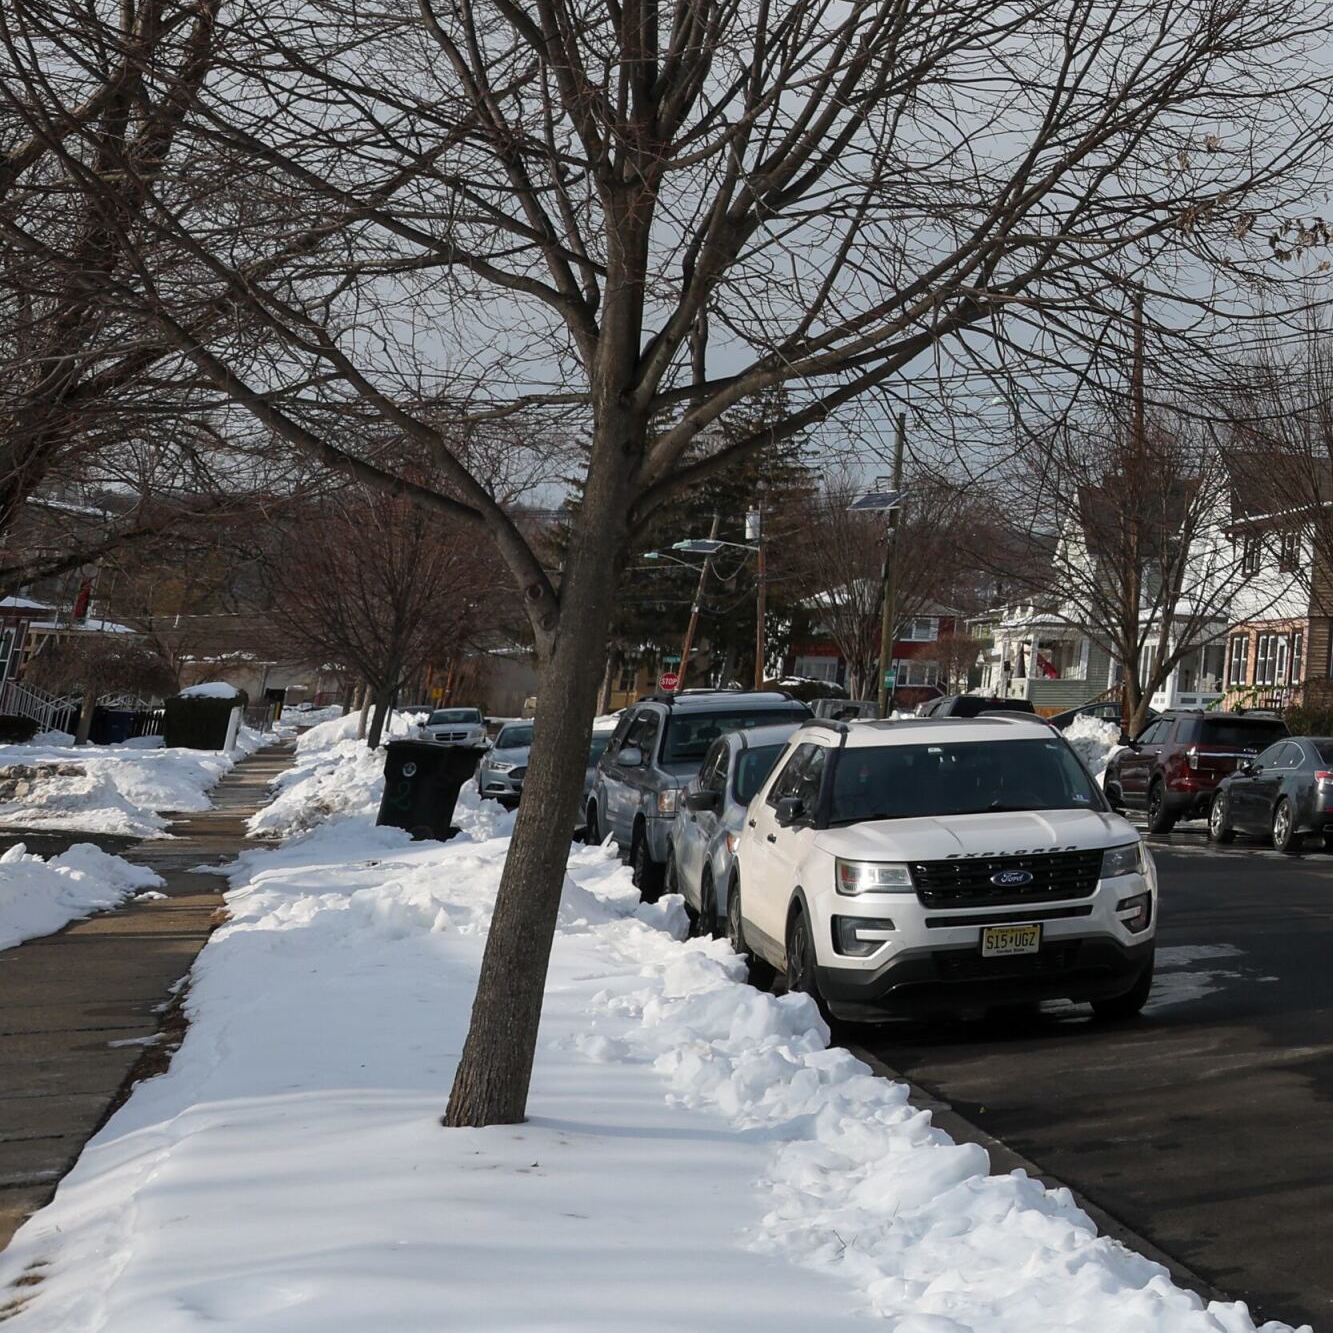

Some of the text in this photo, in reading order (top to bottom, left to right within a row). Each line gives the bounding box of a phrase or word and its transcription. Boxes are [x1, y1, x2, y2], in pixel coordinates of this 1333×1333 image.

[661, 678, 678, 686] STOP
[945, 845, 1078, 859] EXPLORER
[1000, 872, 1023, 883] Ford
